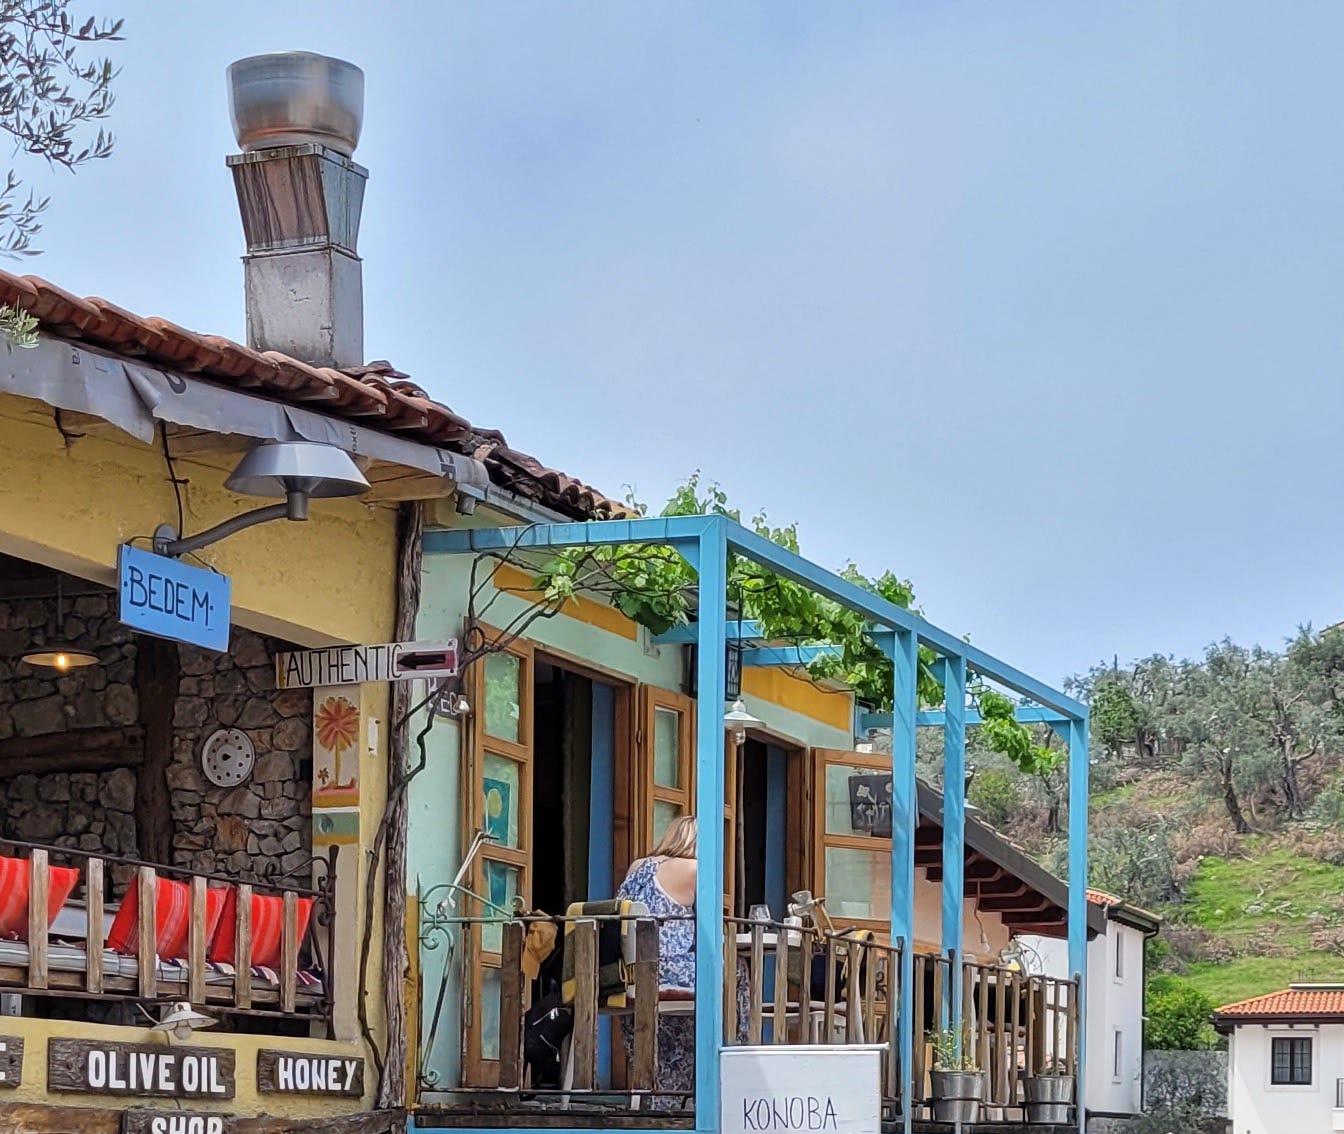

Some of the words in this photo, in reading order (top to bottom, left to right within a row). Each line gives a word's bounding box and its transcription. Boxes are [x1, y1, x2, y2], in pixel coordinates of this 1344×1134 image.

[128, 565, 209, 627] BEDEM
[286, 644, 403, 687] AUTHENTIC
[88, 1050, 175, 1091] OLIVE
[182, 1056, 226, 1093] OIL
[278, 1057, 357, 1091] HONEY
[743, 1096, 838, 1131] KONOBA
